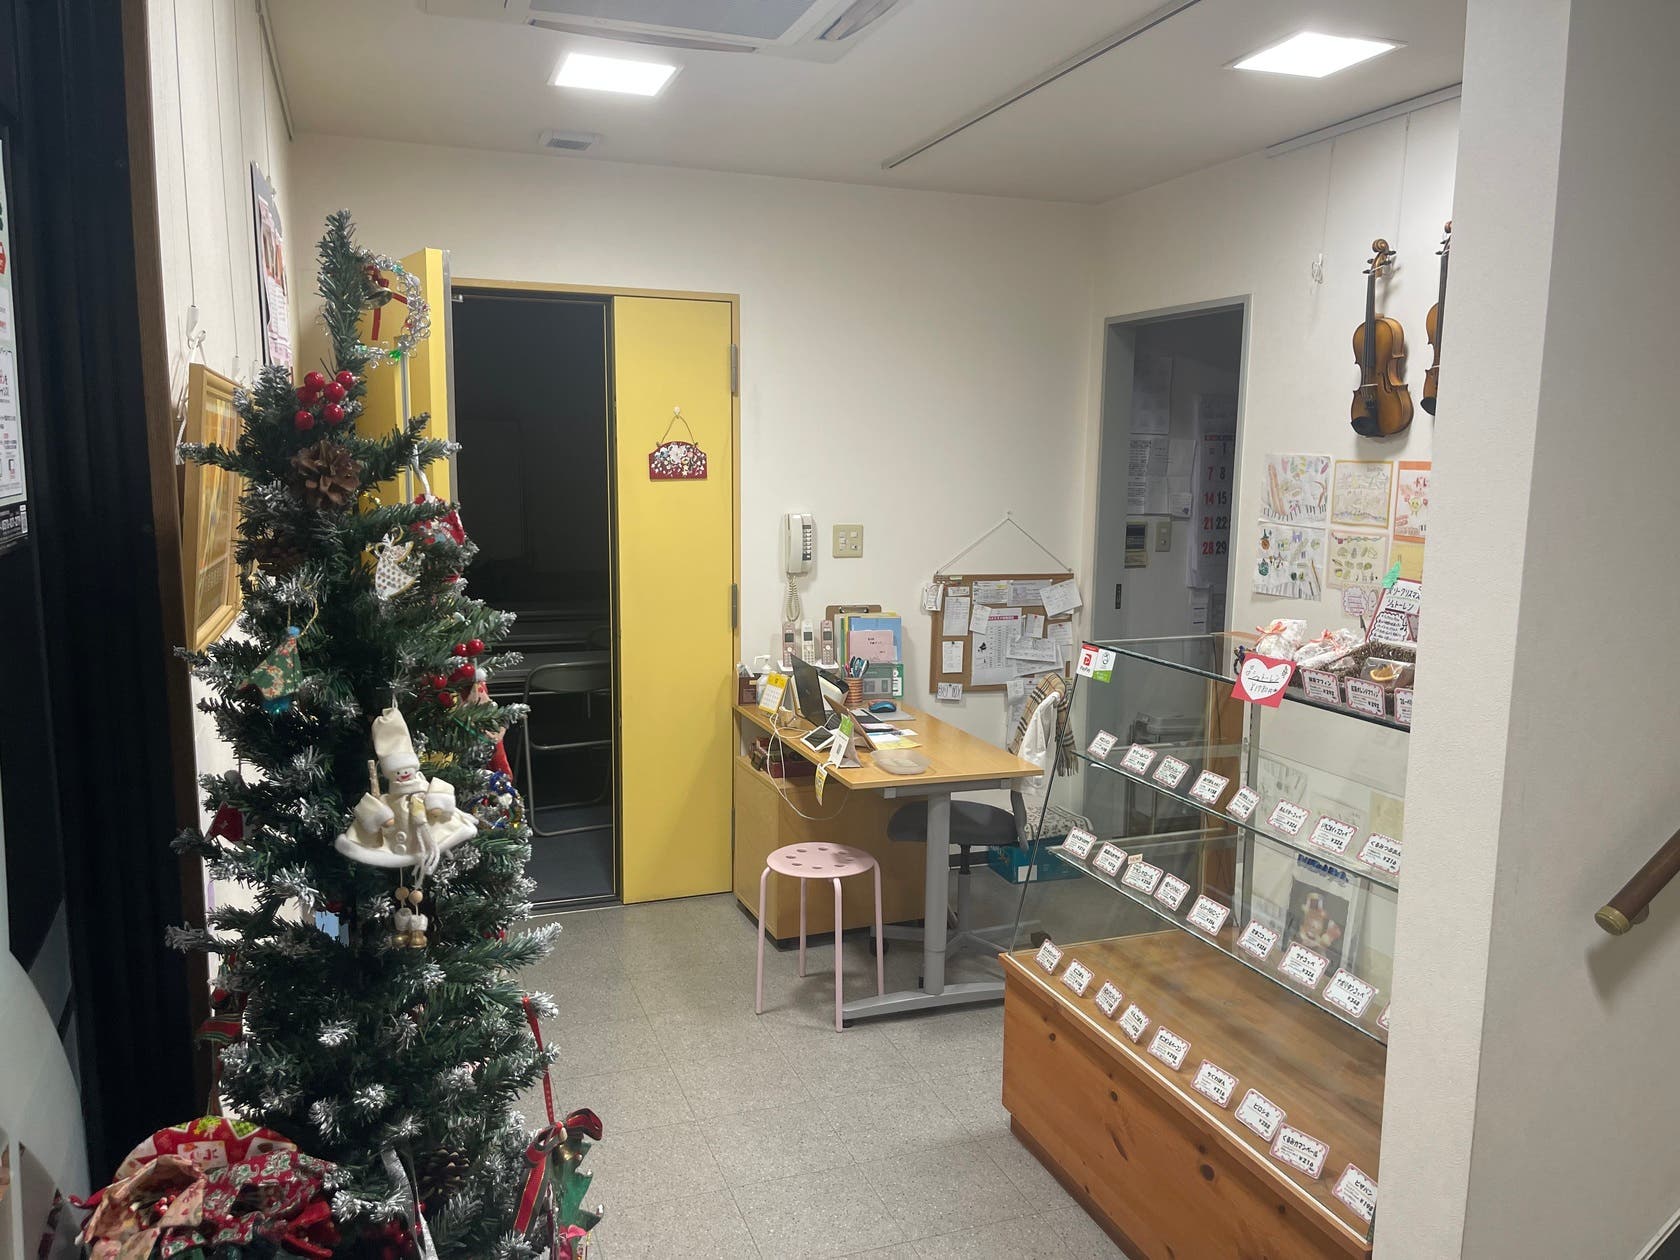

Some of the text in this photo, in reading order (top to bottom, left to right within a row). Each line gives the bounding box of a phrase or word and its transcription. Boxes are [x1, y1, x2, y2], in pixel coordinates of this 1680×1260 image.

[1205, 491, 1227, 505] 14 15
[1203, 516, 1227, 530] 21 22
[1202, 541, 1227, 555] 28 29
[1387, 599, 1414, 612] シュトーレン
